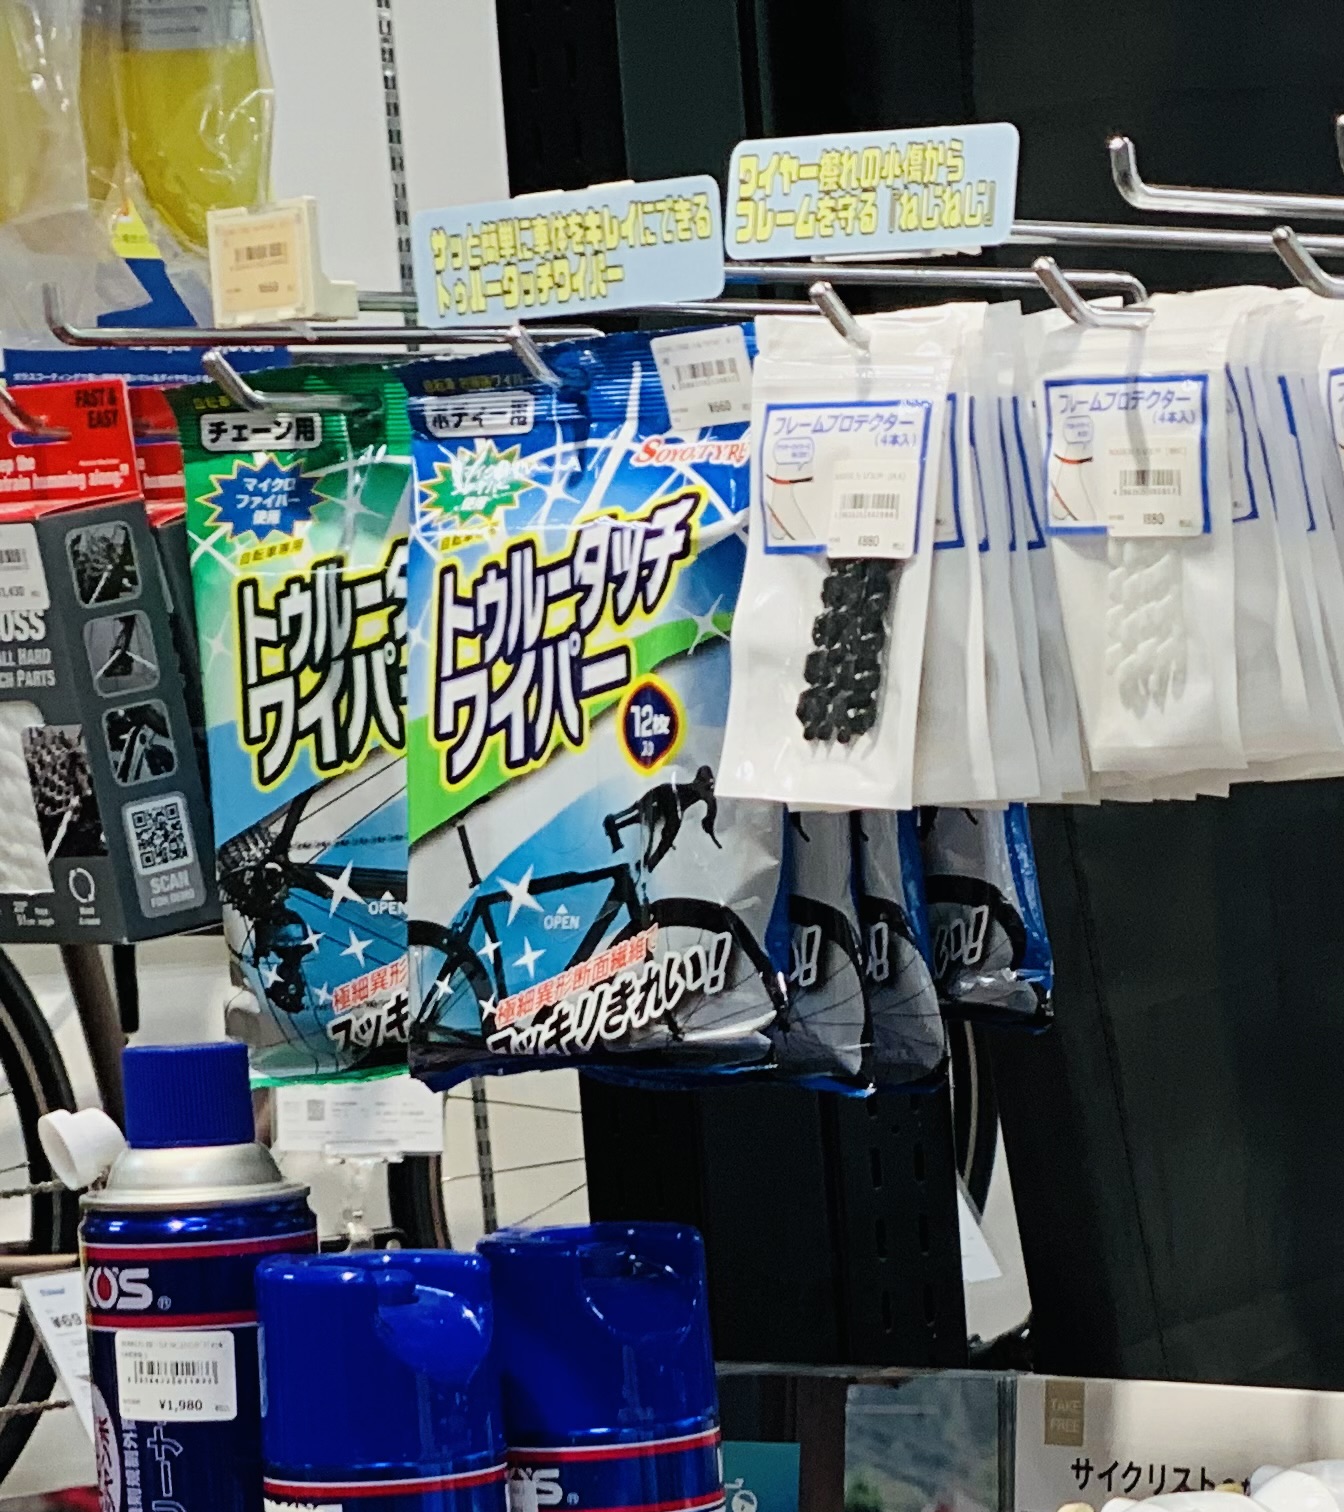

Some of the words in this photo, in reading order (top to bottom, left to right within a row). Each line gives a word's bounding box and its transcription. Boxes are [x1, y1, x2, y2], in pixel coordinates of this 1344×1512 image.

[76, 391, 107, 409] FAST
[88, 409, 118, 428] EASY
[773, 414, 916, 438] フレームプロテクター
[208, 416, 316, 444] チェーン用
[244, 477, 297, 492] マイクロ
[236, 492, 300, 510] ファイバー
[252, 512, 281, 527] 使用
[438, 640, 632, 786] ワイパー
[629, 701, 671, 738] 12枚
[544, 914, 581, 929] OPEN
[159, 1399, 203, 1412] ¥1,980
